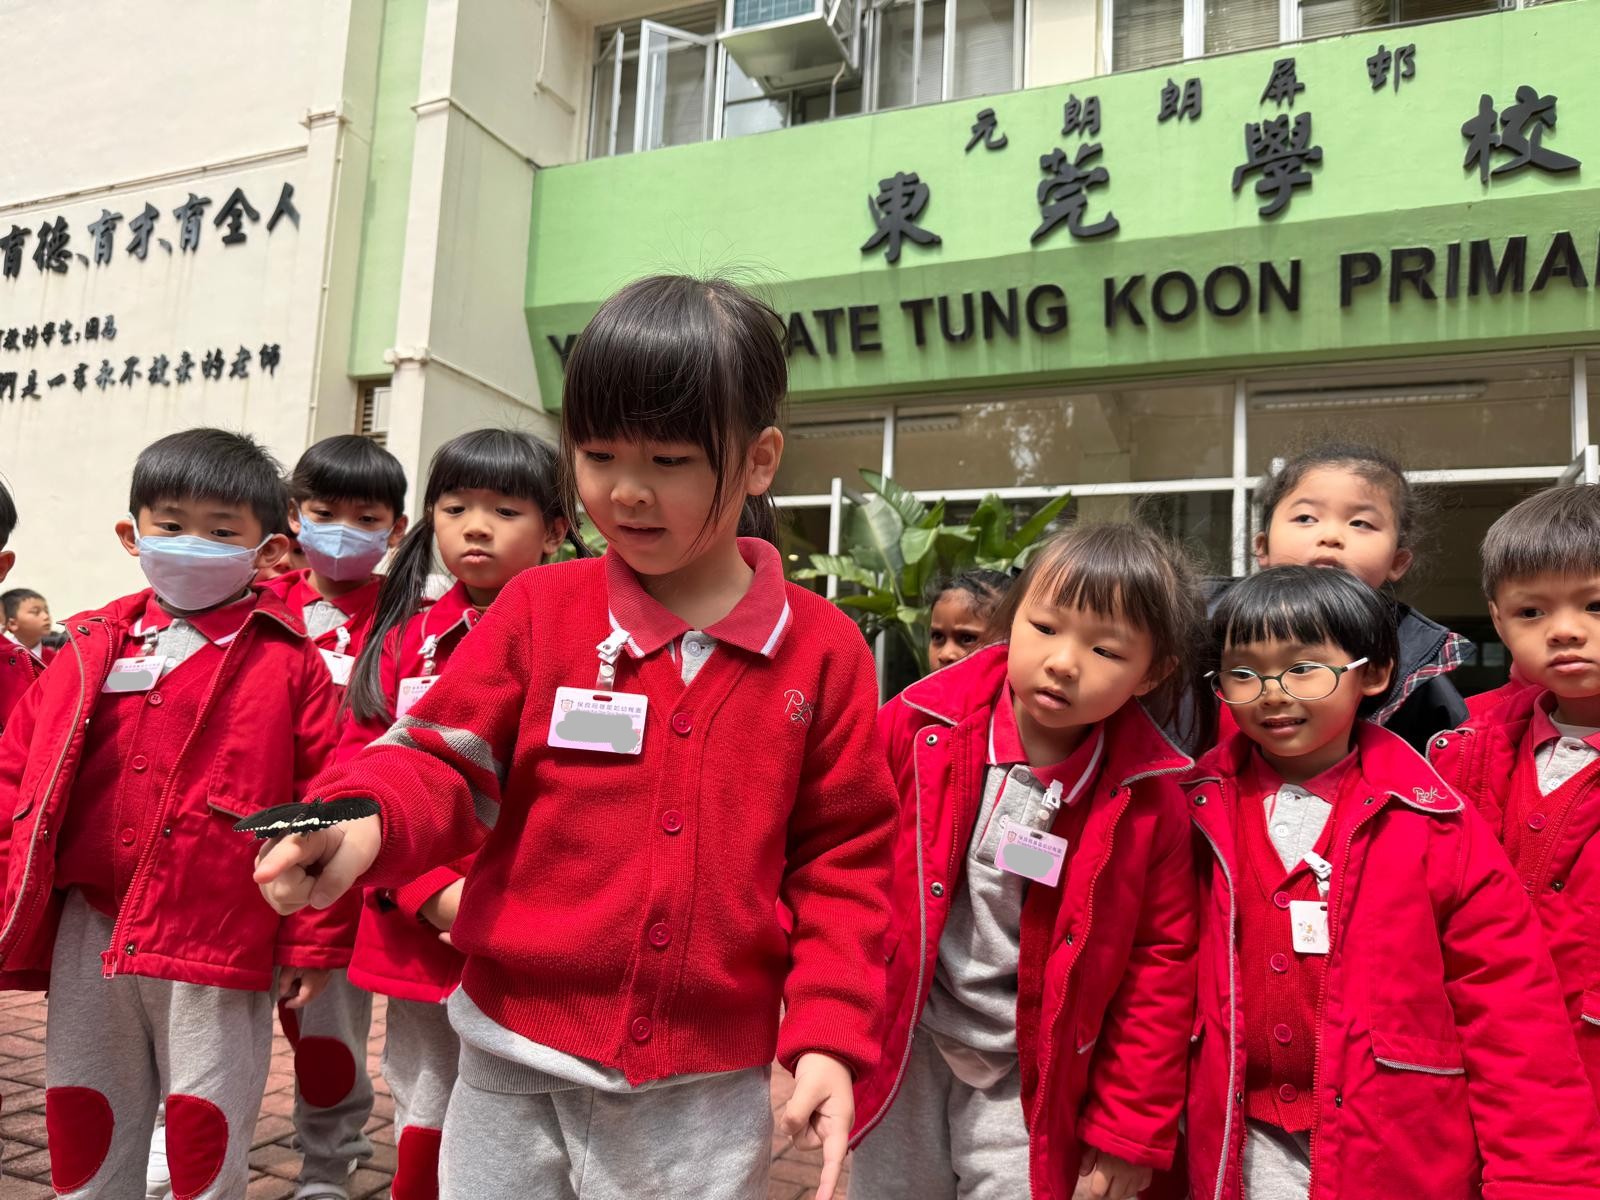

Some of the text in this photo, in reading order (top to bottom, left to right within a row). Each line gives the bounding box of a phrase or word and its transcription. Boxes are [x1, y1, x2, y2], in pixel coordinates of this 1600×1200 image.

[964, 44, 1417, 153] 元朗朗屏邨
[860, 85, 1581, 264] 東莞學校
[785, 228, 1600, 358] ATE TUNG KOON PRIMA
